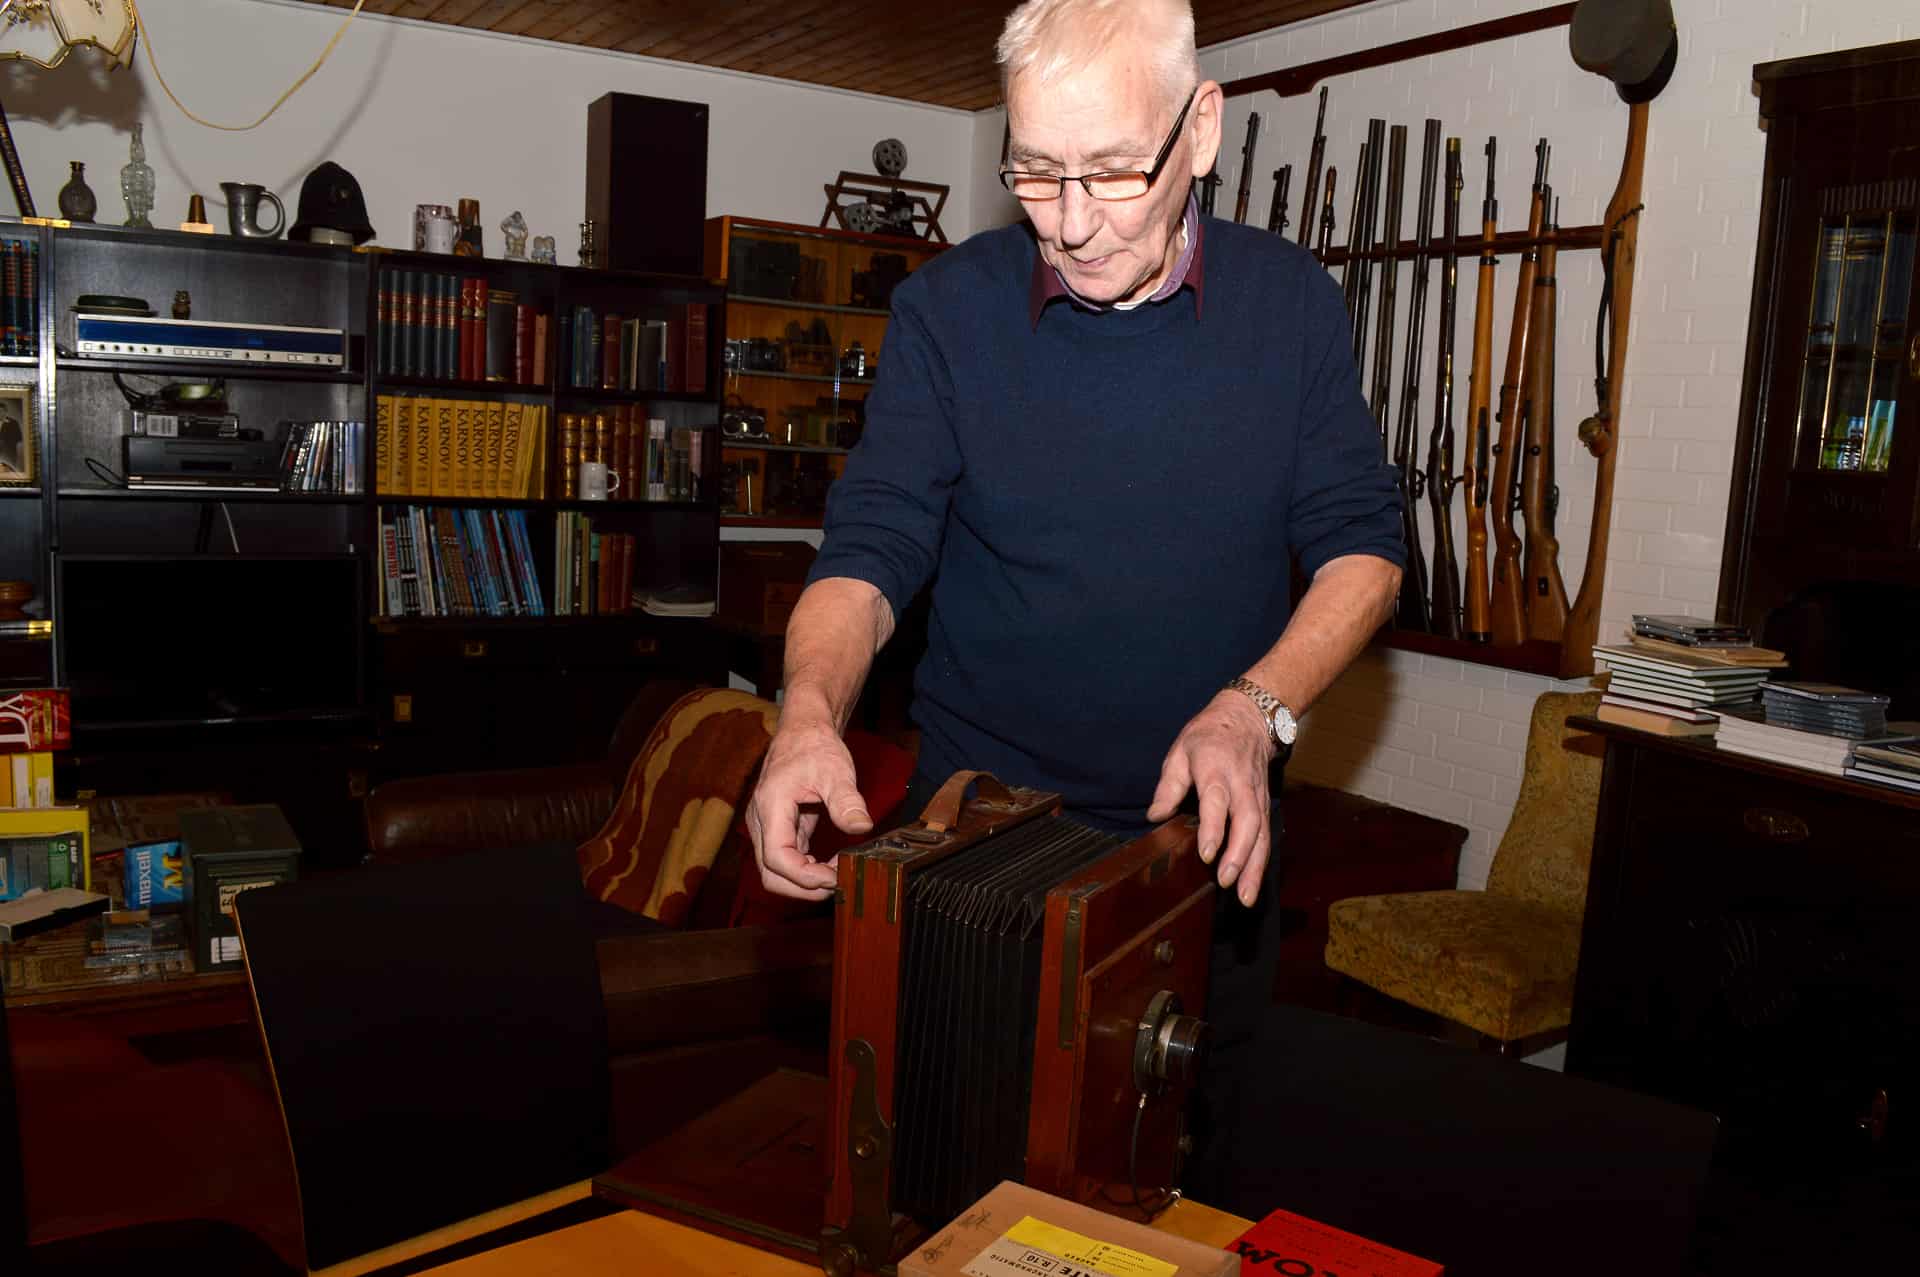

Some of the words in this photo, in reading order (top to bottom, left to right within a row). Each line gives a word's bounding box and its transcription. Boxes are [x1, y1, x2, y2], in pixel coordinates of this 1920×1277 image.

[416, 406, 430, 466] KARNOV
[439, 407, 451, 467] KARNOV
[456, 408, 469, 467] KARNOV
[472, 409, 485, 467] KARNOV
[487, 409, 501, 467] KARNOV
[503, 410, 521, 468] KARNOV
[136, 850, 153, 905] maxell
